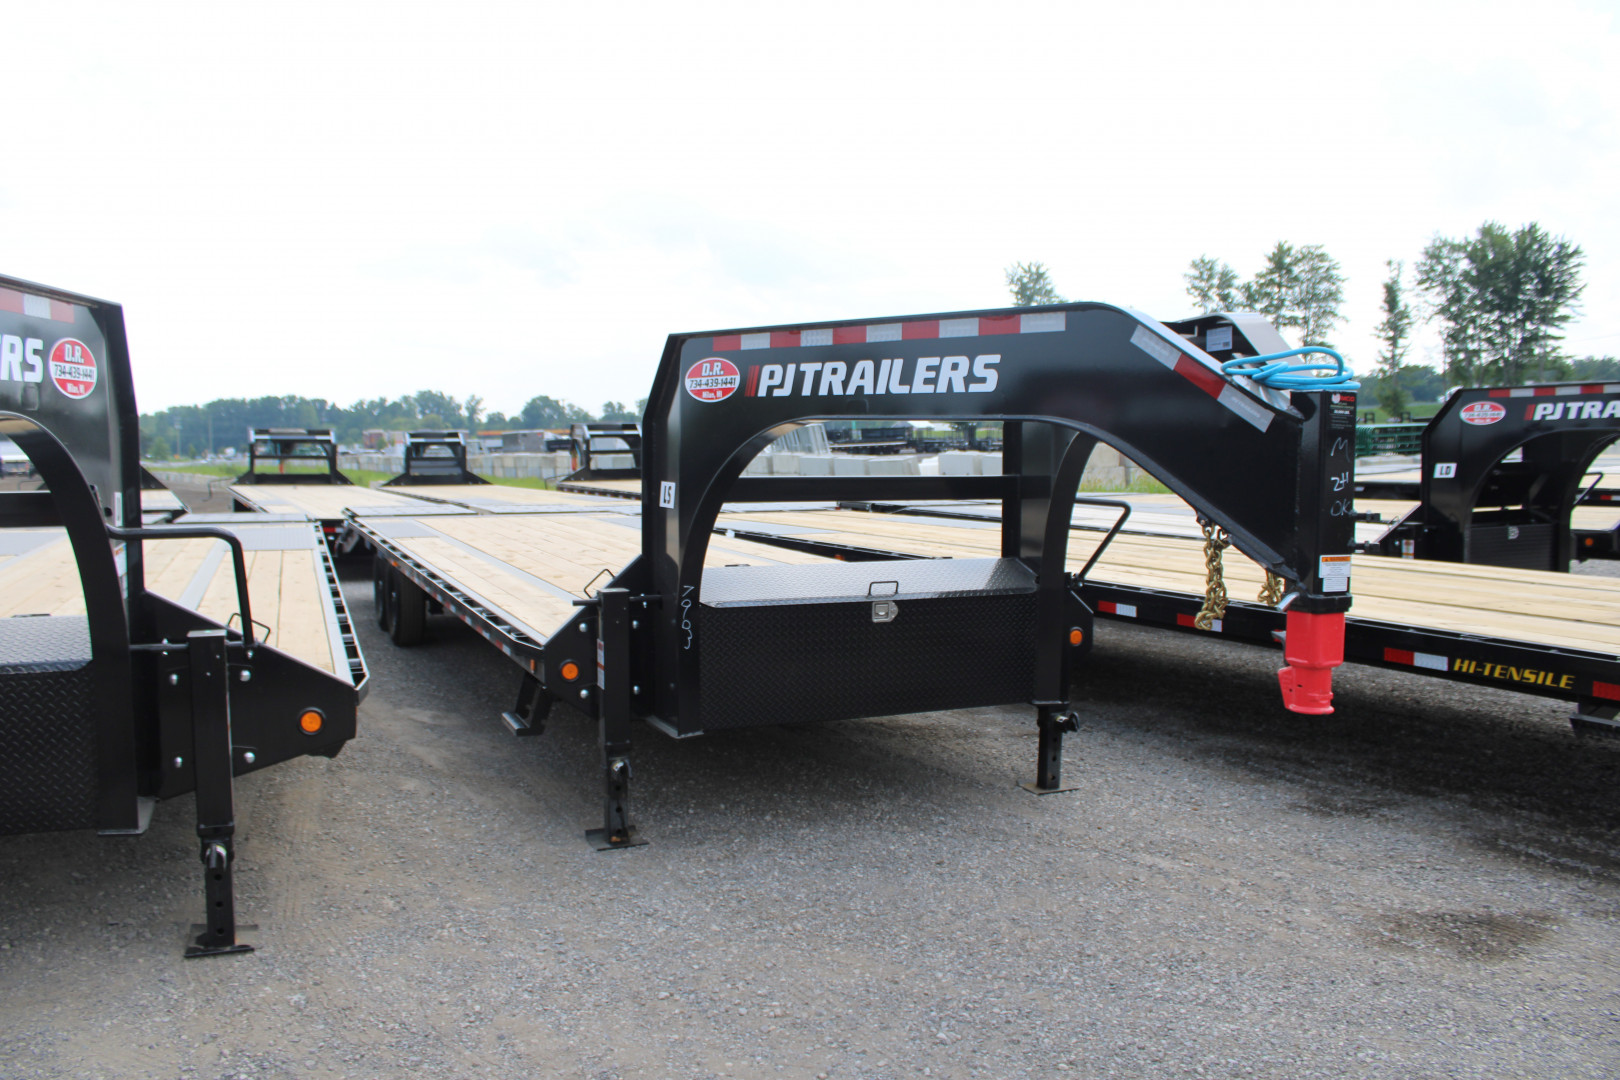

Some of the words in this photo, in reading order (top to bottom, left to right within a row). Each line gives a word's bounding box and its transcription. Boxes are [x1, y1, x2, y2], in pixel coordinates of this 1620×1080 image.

[0, 333, 44, 383] RS
[64, 343, 84, 364] D.R.
[701, 362, 724, 377] D.R.
[690, 377, 736, 389] 734-439-1441
[1453, 658, 1576, 690] HI-TENSILE
